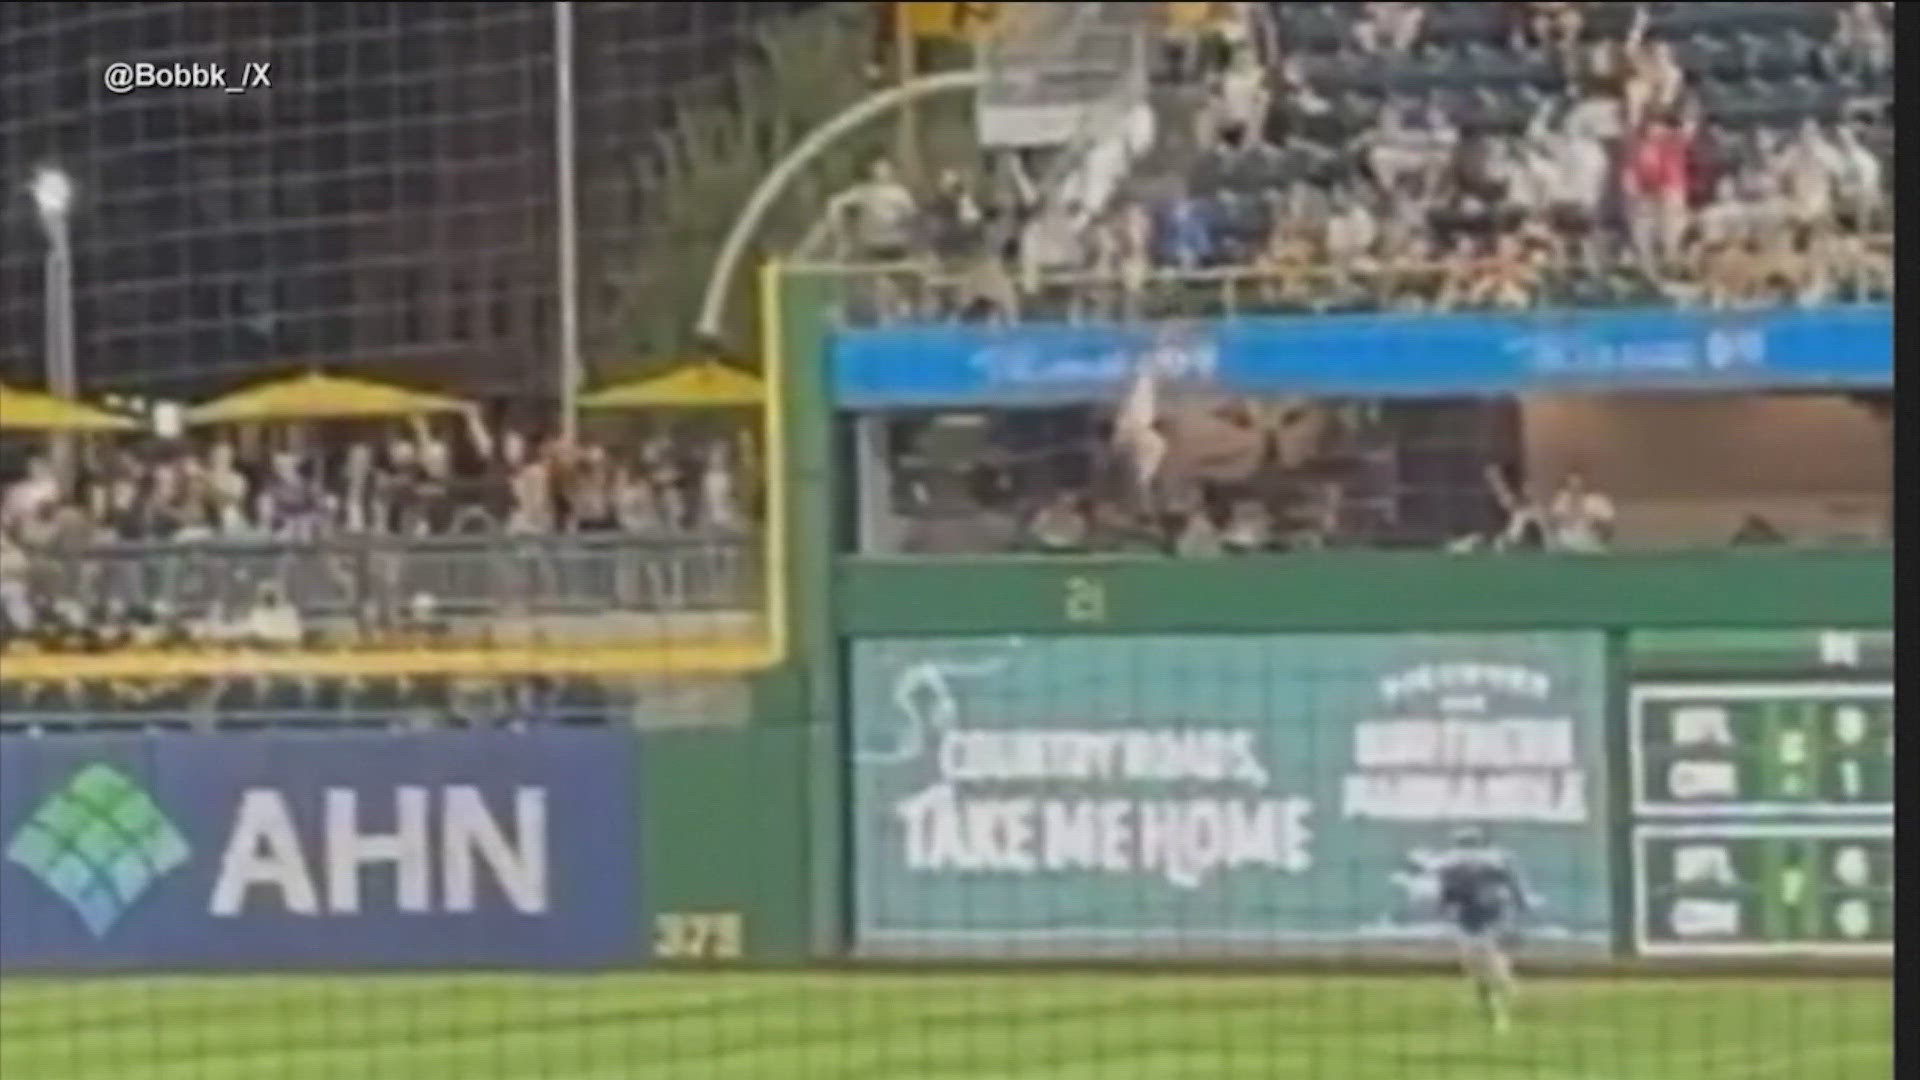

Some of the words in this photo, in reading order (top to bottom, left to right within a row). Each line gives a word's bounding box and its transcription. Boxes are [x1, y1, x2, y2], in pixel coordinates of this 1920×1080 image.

[209, 785, 548, 916] AHN
[898, 784, 1038, 870] TAKE
[1043, 799, 1133, 870] ME
[1140, 798, 1313, 888] HOME
